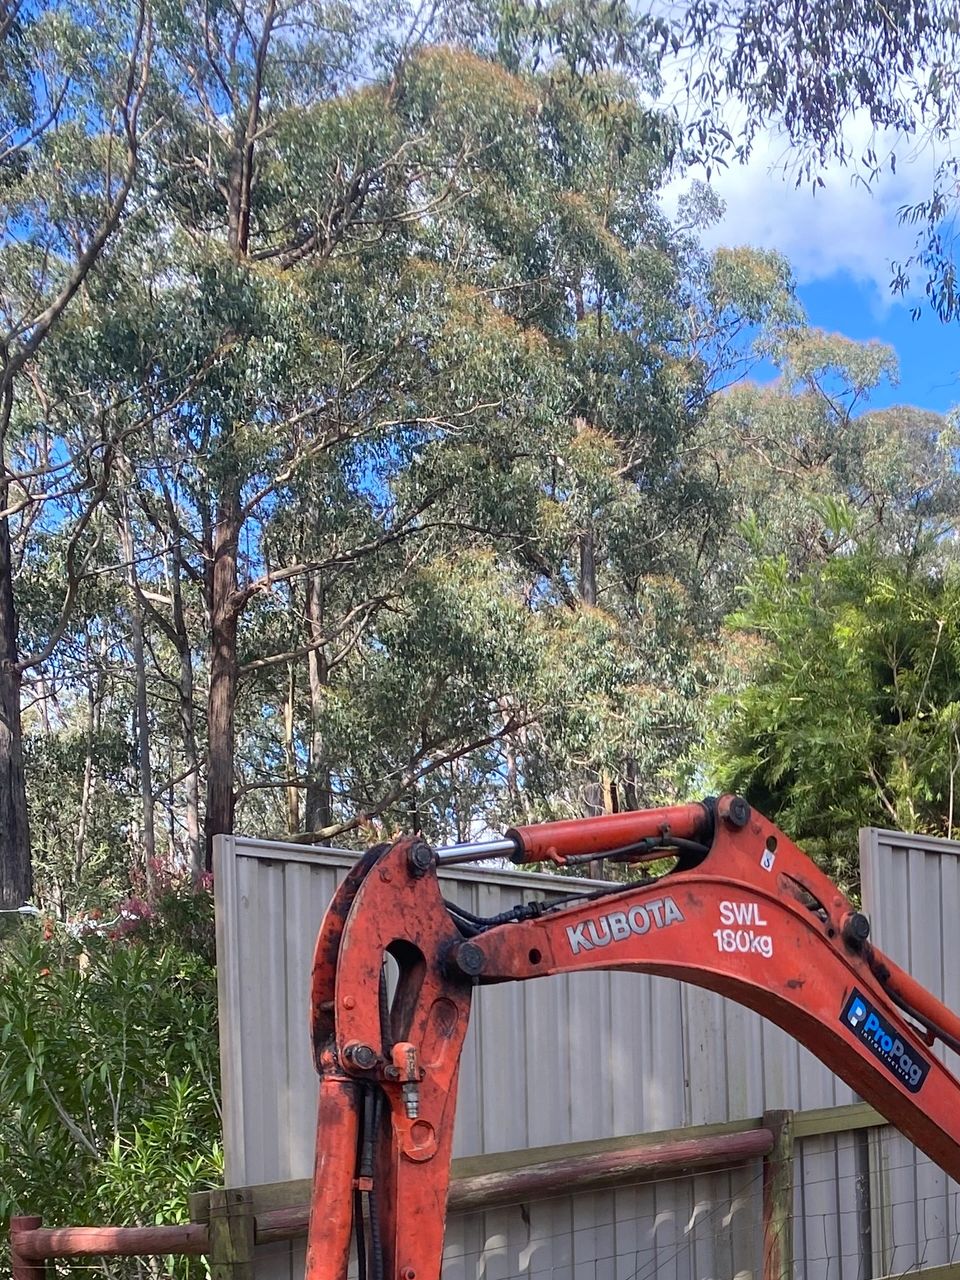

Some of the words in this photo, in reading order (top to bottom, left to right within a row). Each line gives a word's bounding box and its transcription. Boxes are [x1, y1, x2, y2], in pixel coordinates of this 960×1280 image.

[566, 897, 684, 954] KUBOTA
[719, 901, 767, 926] SWL
[713, 929, 773, 958] 180kg
[864, 1012, 922, 1085] ProPag
